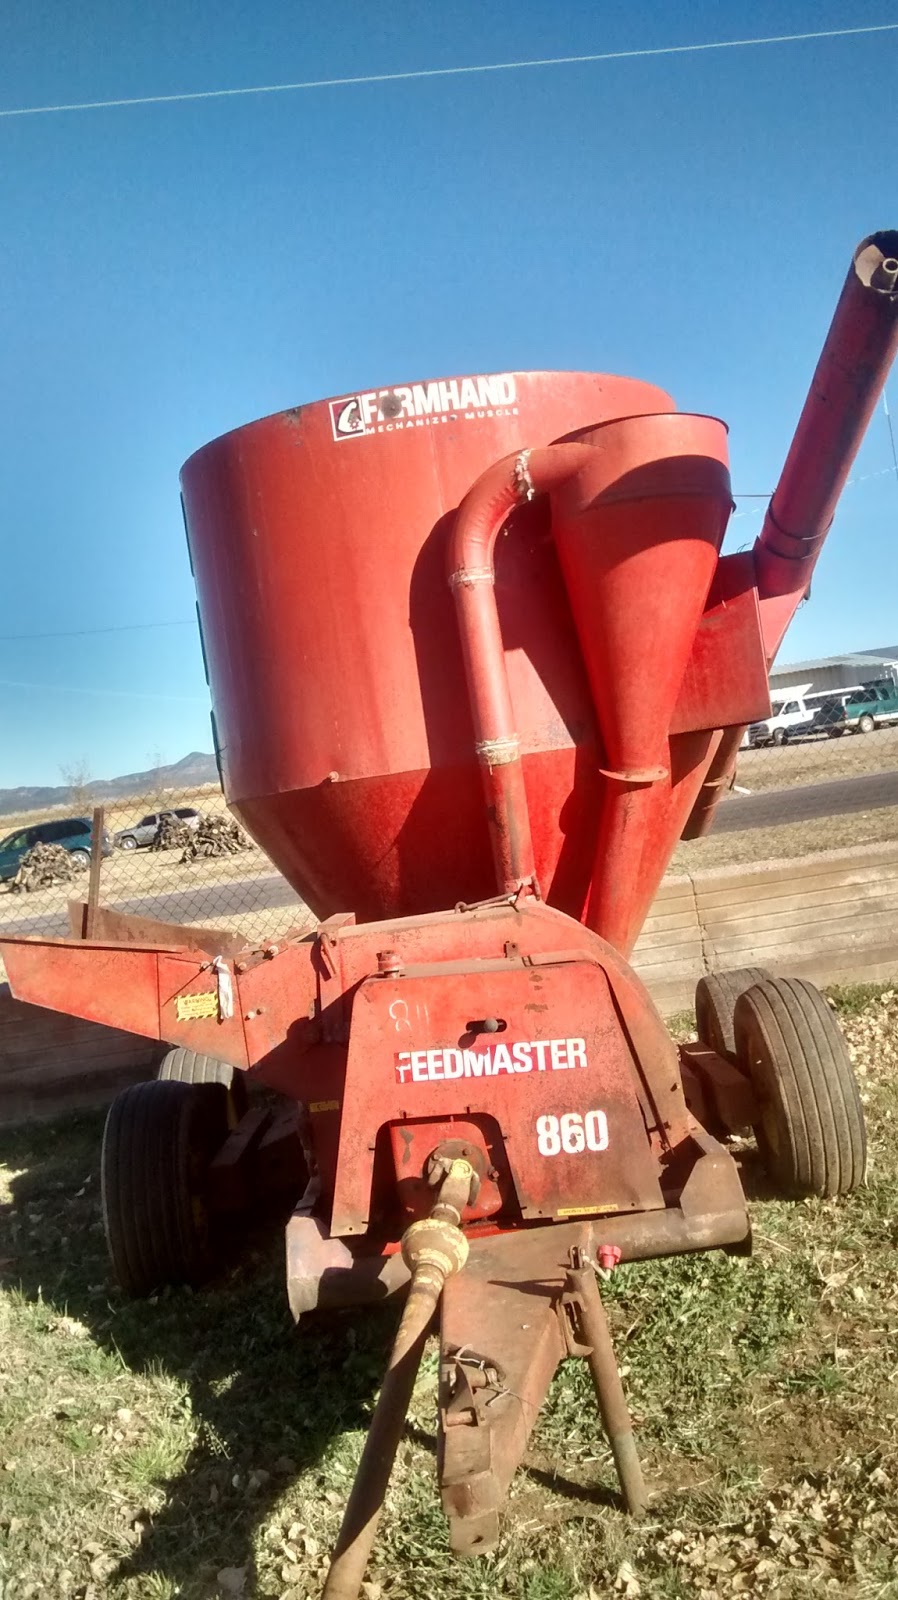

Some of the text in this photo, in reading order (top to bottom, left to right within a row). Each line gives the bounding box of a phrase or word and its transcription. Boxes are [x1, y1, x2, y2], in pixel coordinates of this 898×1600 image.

[464, 407, 519, 420] MUSCLE
[396, 1037, 588, 1083] FEEDMASTER
[536, 1110, 609, 1156] 860
